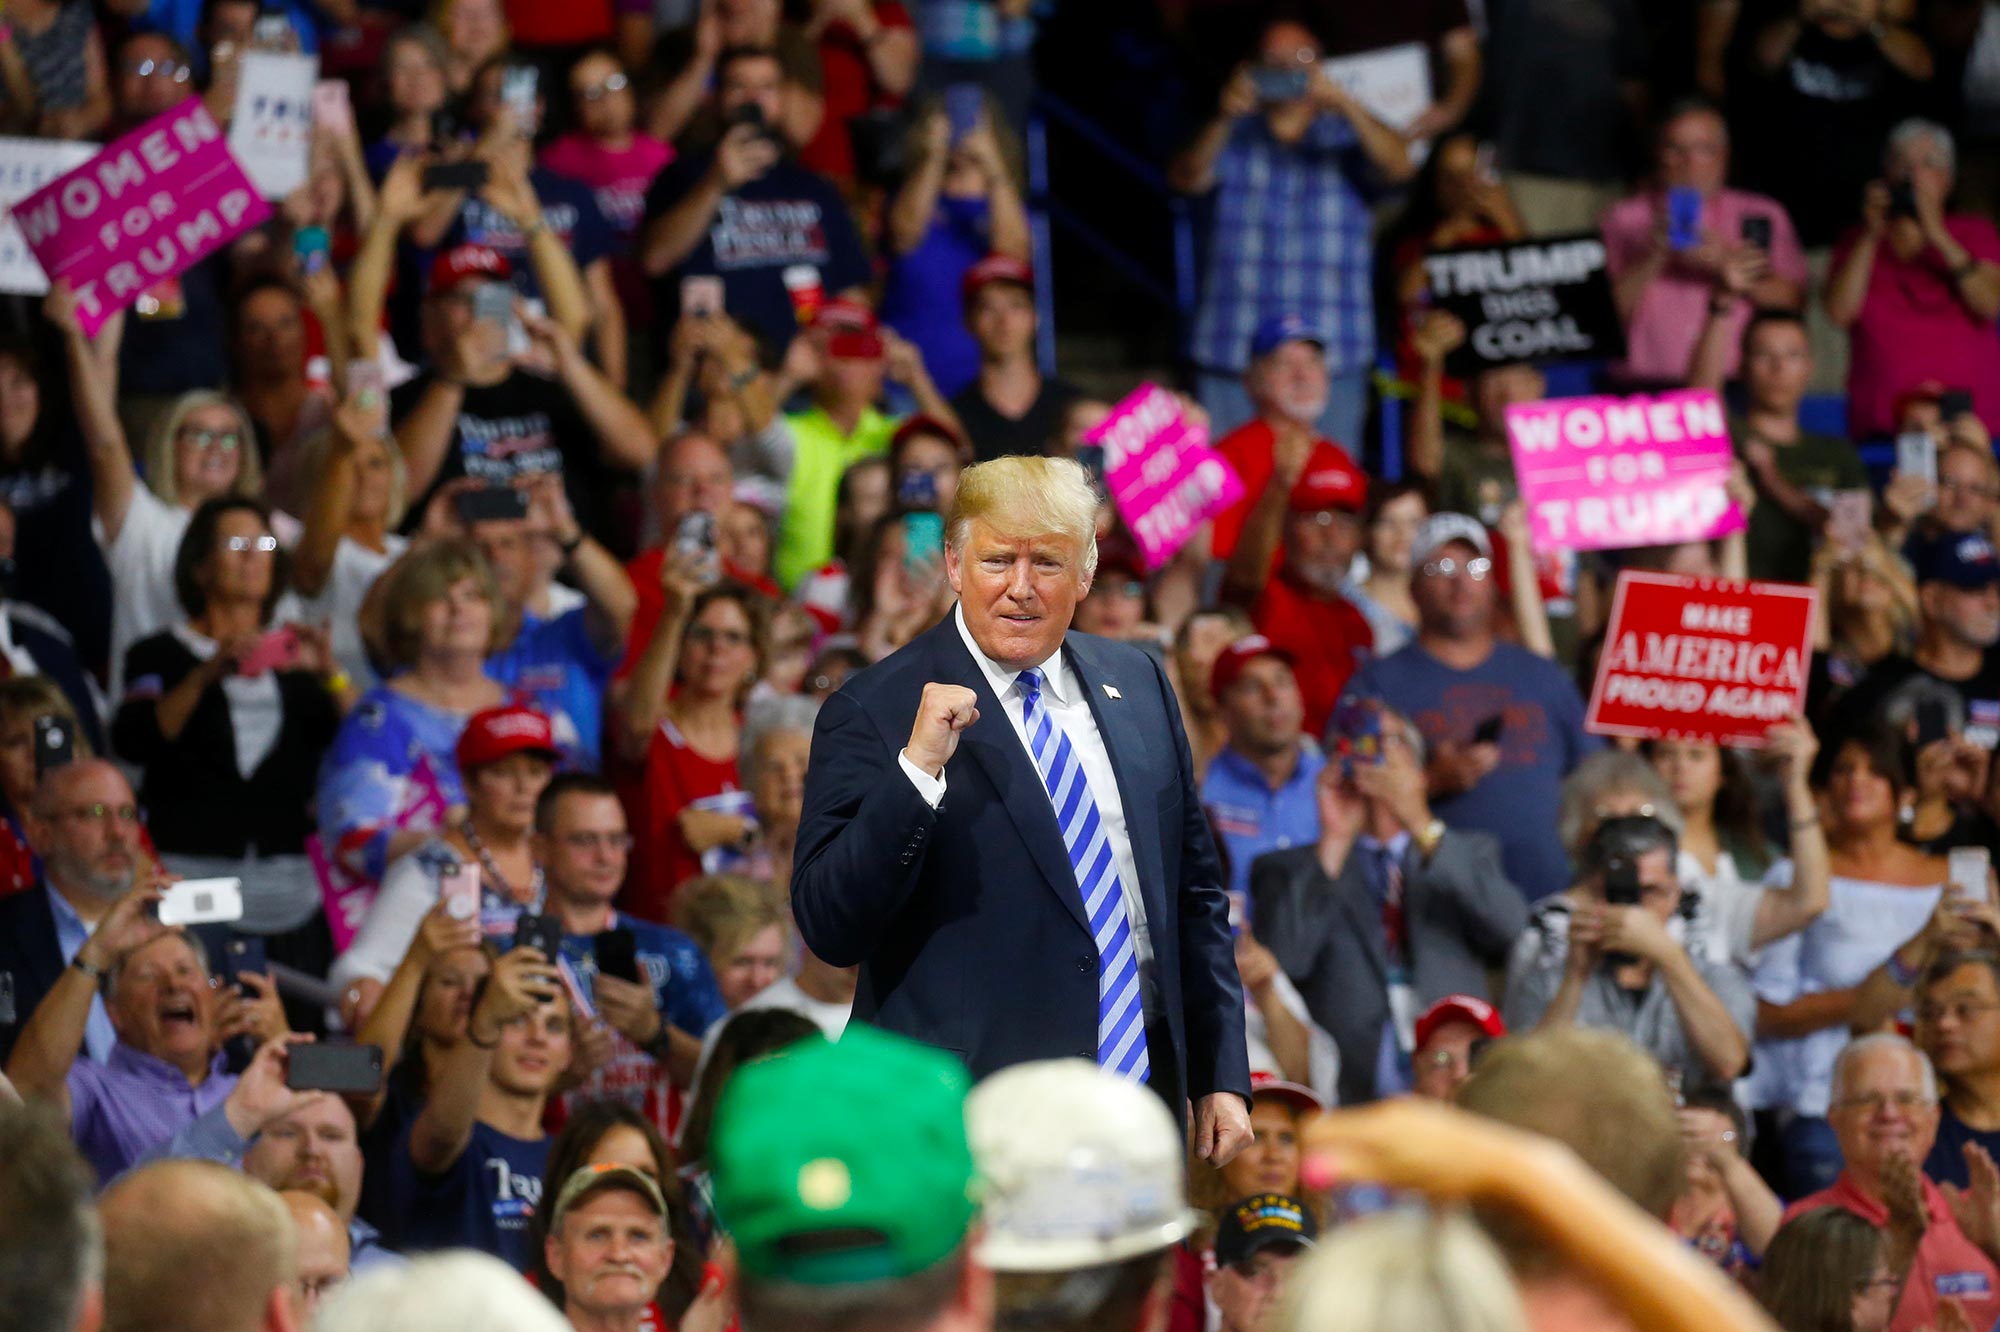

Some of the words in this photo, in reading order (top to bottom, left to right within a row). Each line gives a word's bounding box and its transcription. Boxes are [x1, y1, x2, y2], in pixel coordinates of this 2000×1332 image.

[18, 105, 220, 247] WOMEN
[99, 190, 178, 252] FOR
[73, 188, 251, 319] TRUMP
[1421, 239, 1607, 297] TRUMP
[1471, 313, 1594, 360] COAL
[1507, 398, 1726, 453] WOMEN
[1585, 450, 1667, 488] FOR
[1536, 486, 1730, 540] TRUMP
[1680, 601, 1753, 637] MAKE
[1603, 630, 1801, 688] AMERICA
[1603, 672, 1707, 714] PROUD
